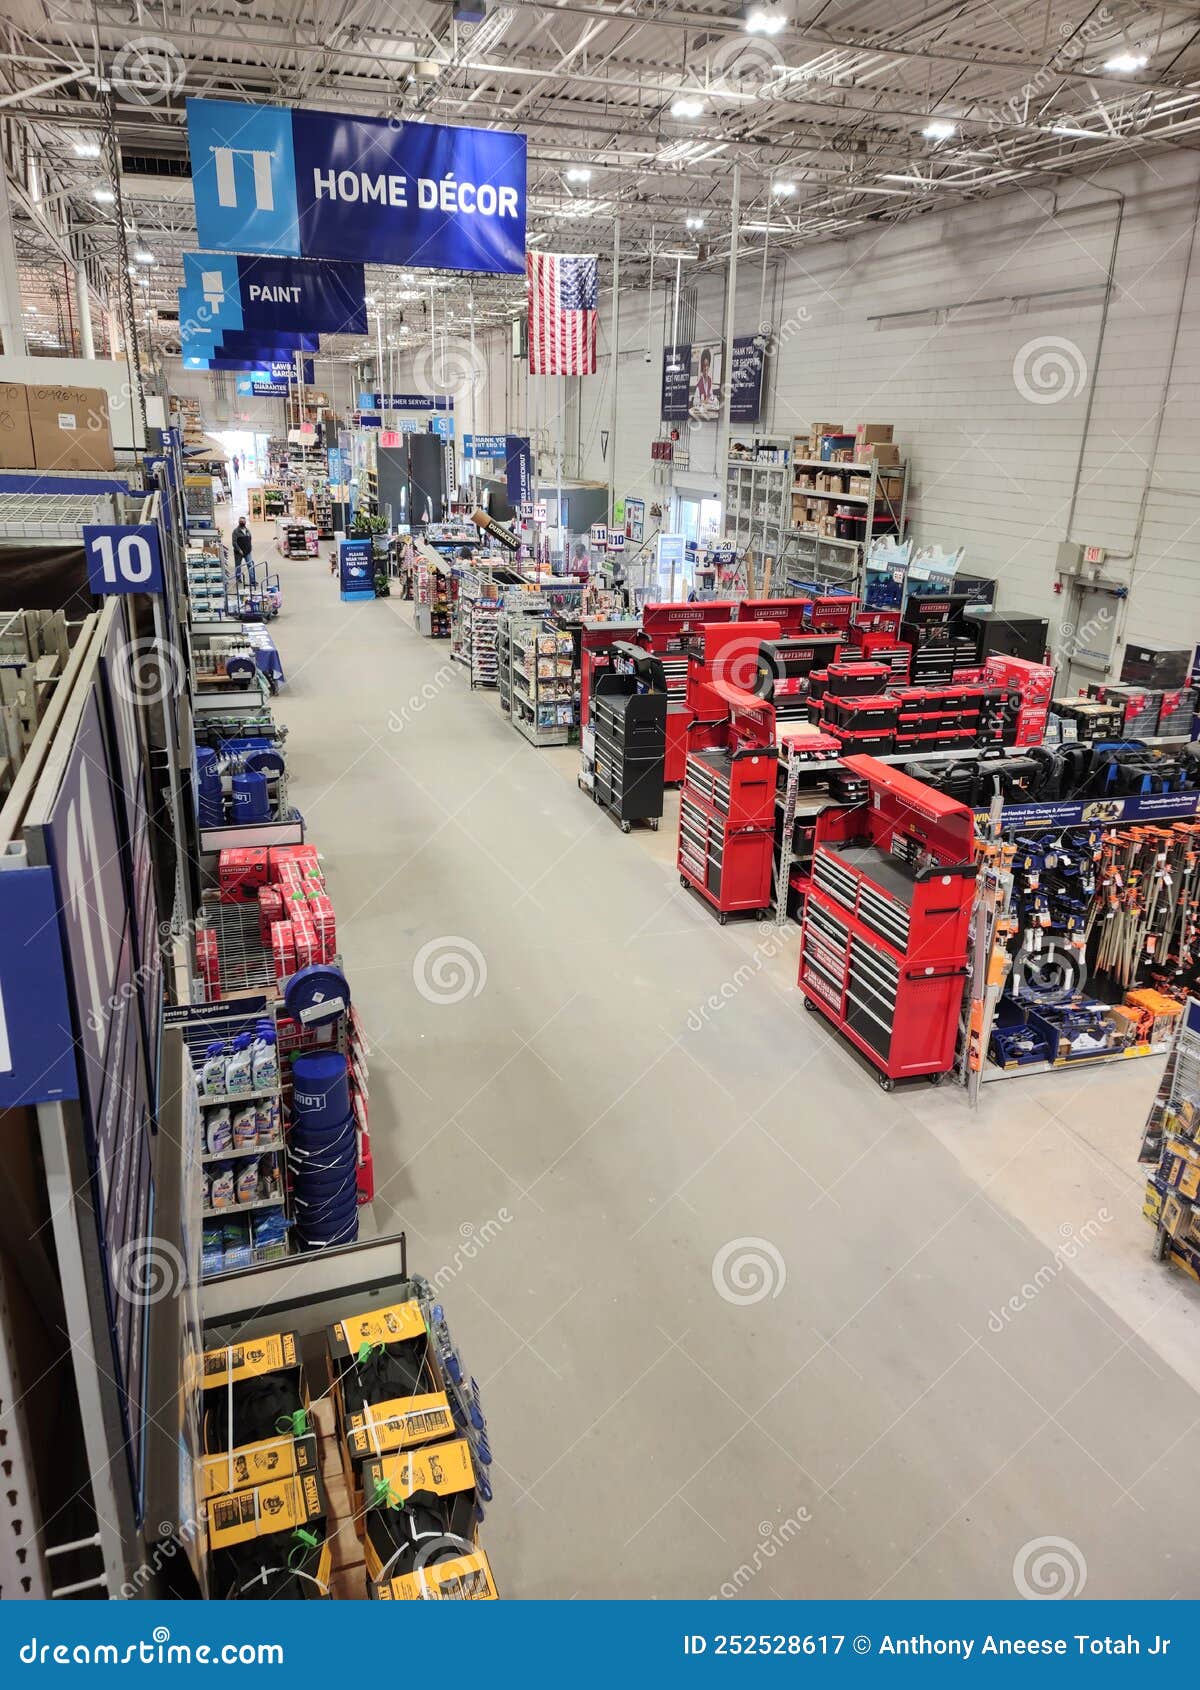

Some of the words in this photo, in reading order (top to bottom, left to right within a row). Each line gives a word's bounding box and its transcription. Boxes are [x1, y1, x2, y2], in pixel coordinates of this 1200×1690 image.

[312, 166, 408, 209] HOME
[416, 172, 519, 218] DÉCOR
[248, 284, 301, 305] PAINT
[162, 433, 171, 445] 5
[524, 505, 533, 514] 13
[535, 508, 546, 518] 12
[488, 522, 518, 547] DURACELL
[596, 529, 606, 540] 11
[614, 534, 624, 546] 10
[722, 541, 732, 551] 20
[91, 535, 152, 583] 10
[670, 612, 702, 620] CRAFTSMAN
[817, 607, 848, 615] CRAFTSMAN
[776, 651, 812, 661] CRAFTSMAN
[190, 1003, 230, 1015] Supplies
[283, 1334, 297, 1365] DEWALT
[303, 1474, 322, 1514] DEWALT
